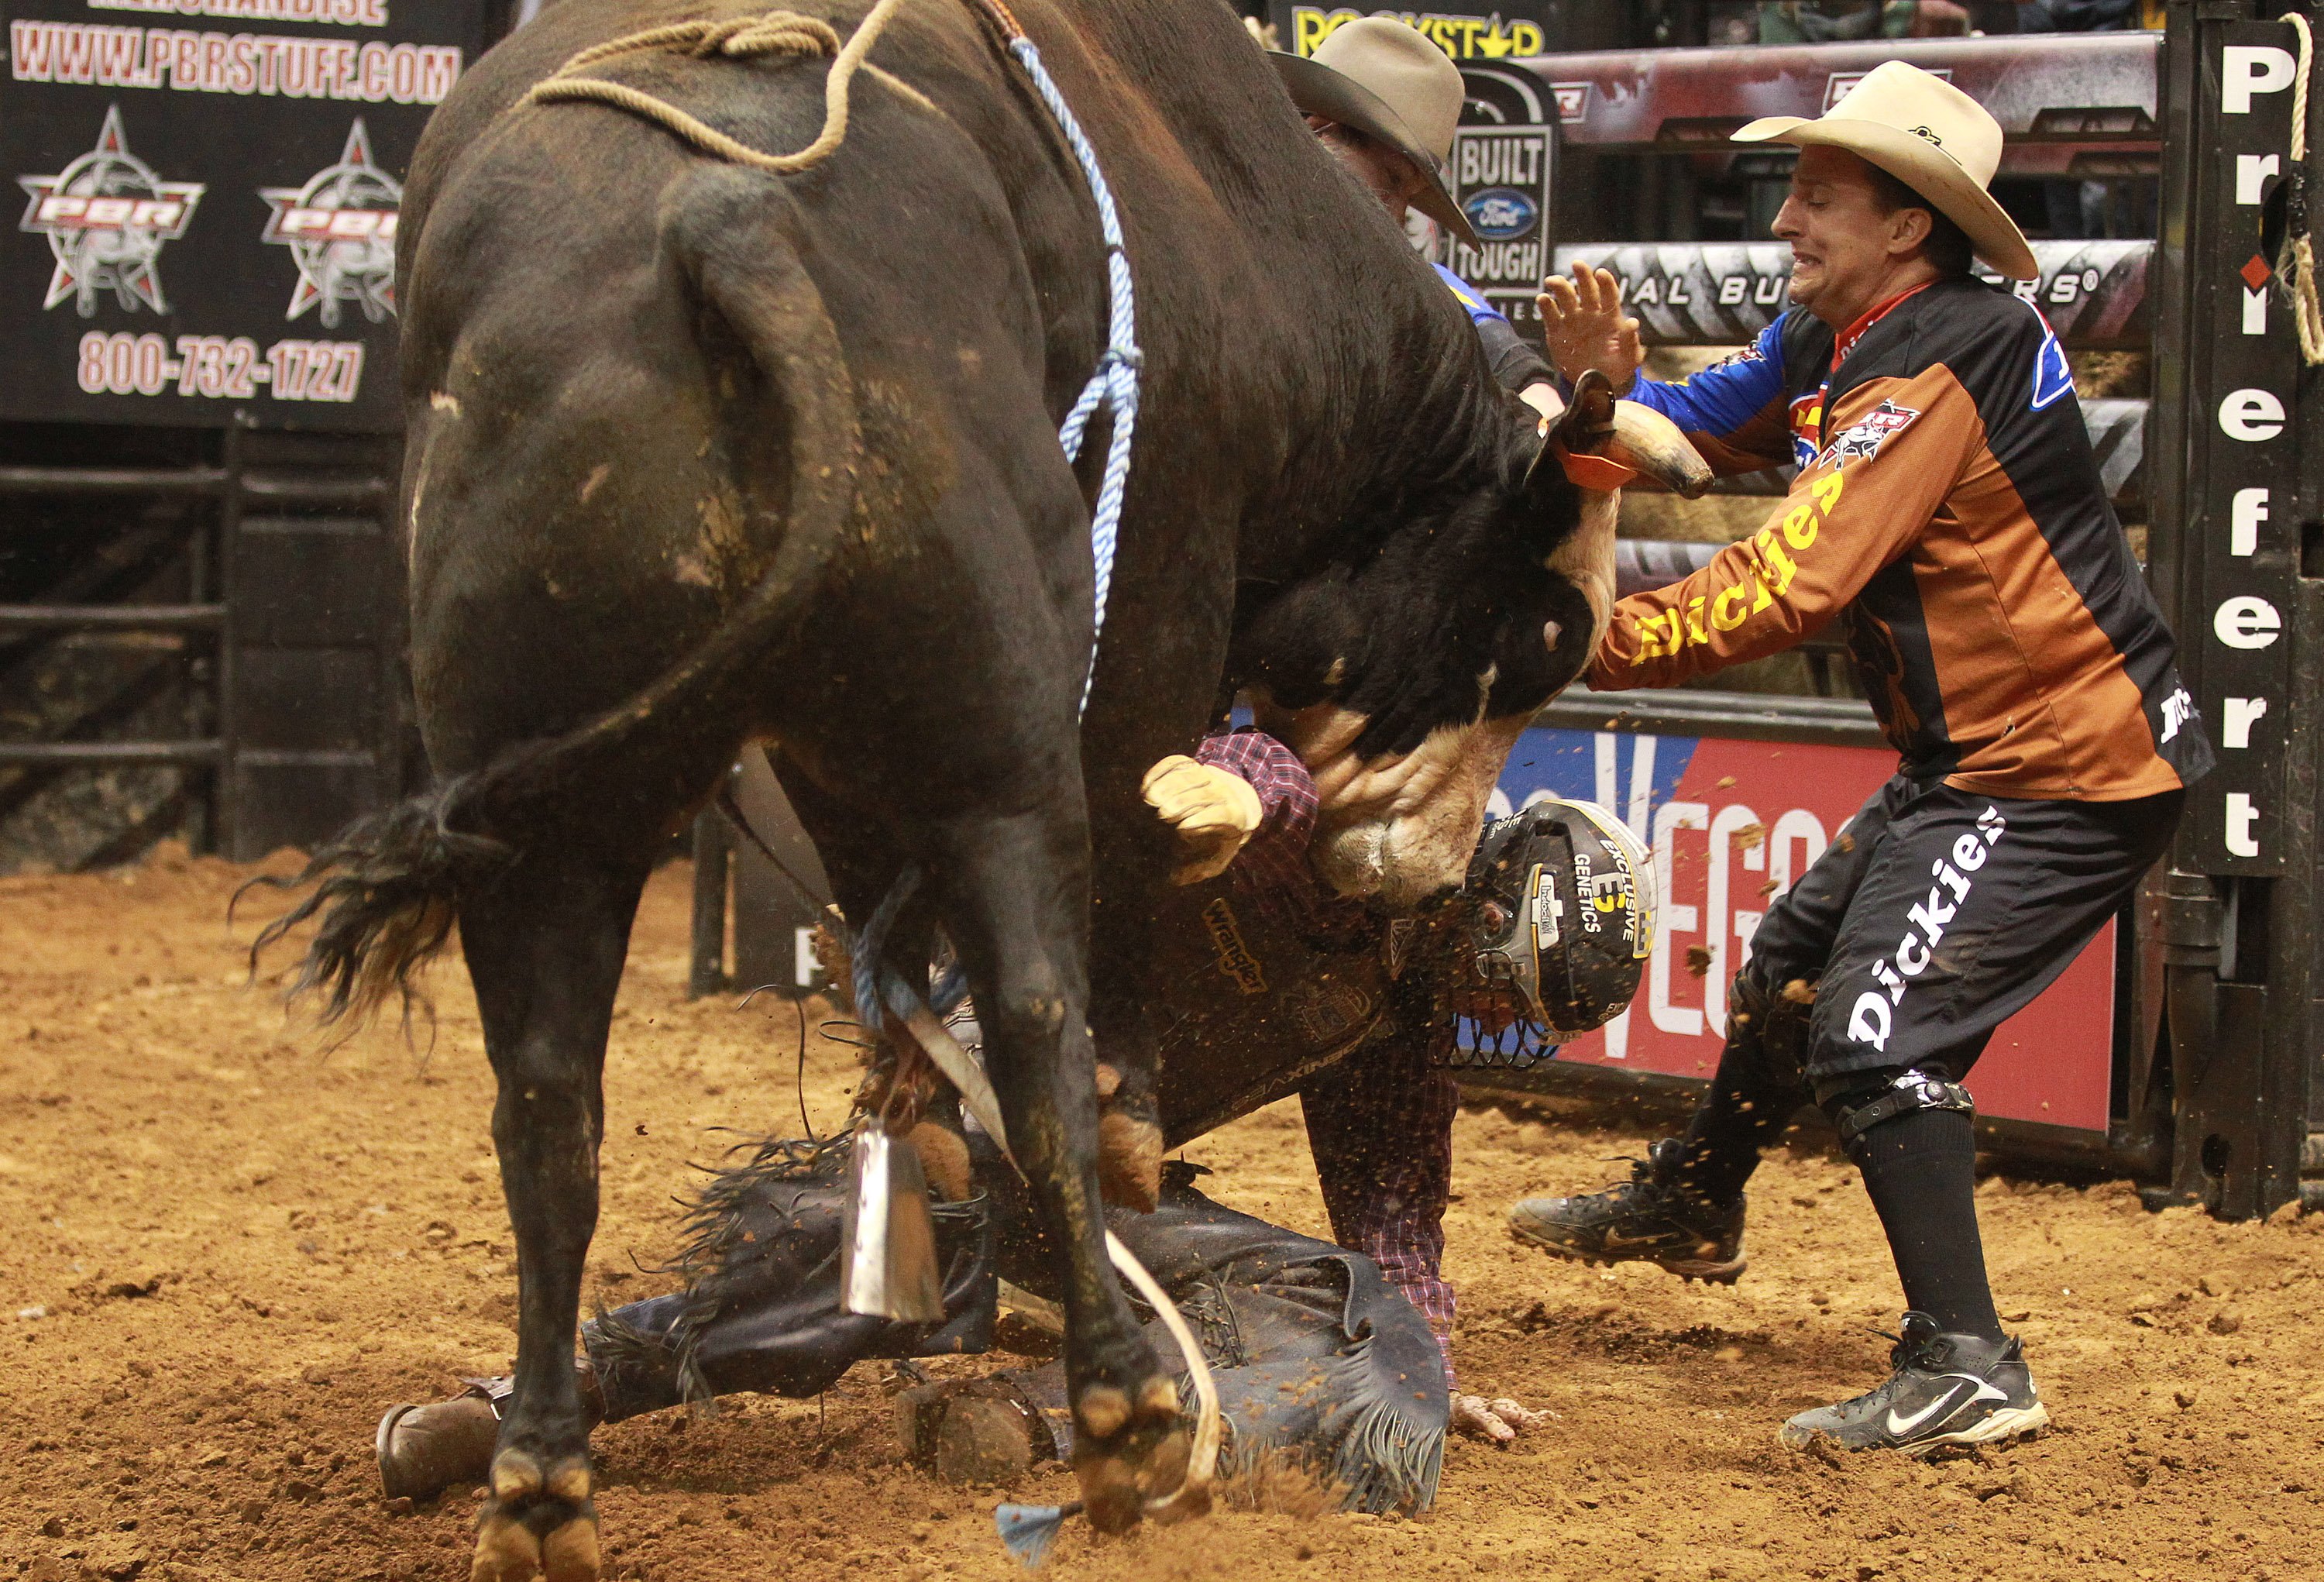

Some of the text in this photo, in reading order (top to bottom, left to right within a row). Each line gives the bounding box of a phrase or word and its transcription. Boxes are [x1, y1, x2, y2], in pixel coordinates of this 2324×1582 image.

[10, 19, 462, 105] WWW.PBRSTUFF.COM
[1460, 138, 1543, 185] BUILT
[38, 196, 185, 227] PBR
[1478, 200, 1519, 227] Ford
[1456, 242, 1539, 281] TOUGH
[78, 330, 365, 403] 800-732-1727
[2213, 45, 2296, 858] Priefert
[1630, 469, 1844, 666] Dickies
[1573, 853, 1602, 934] GENETICS
[1600, 838, 1635, 942] EXCLUSIVE
[1847, 805, 2006, 1053] Dickies
[1205, 901, 1264, 990] Wrangler
